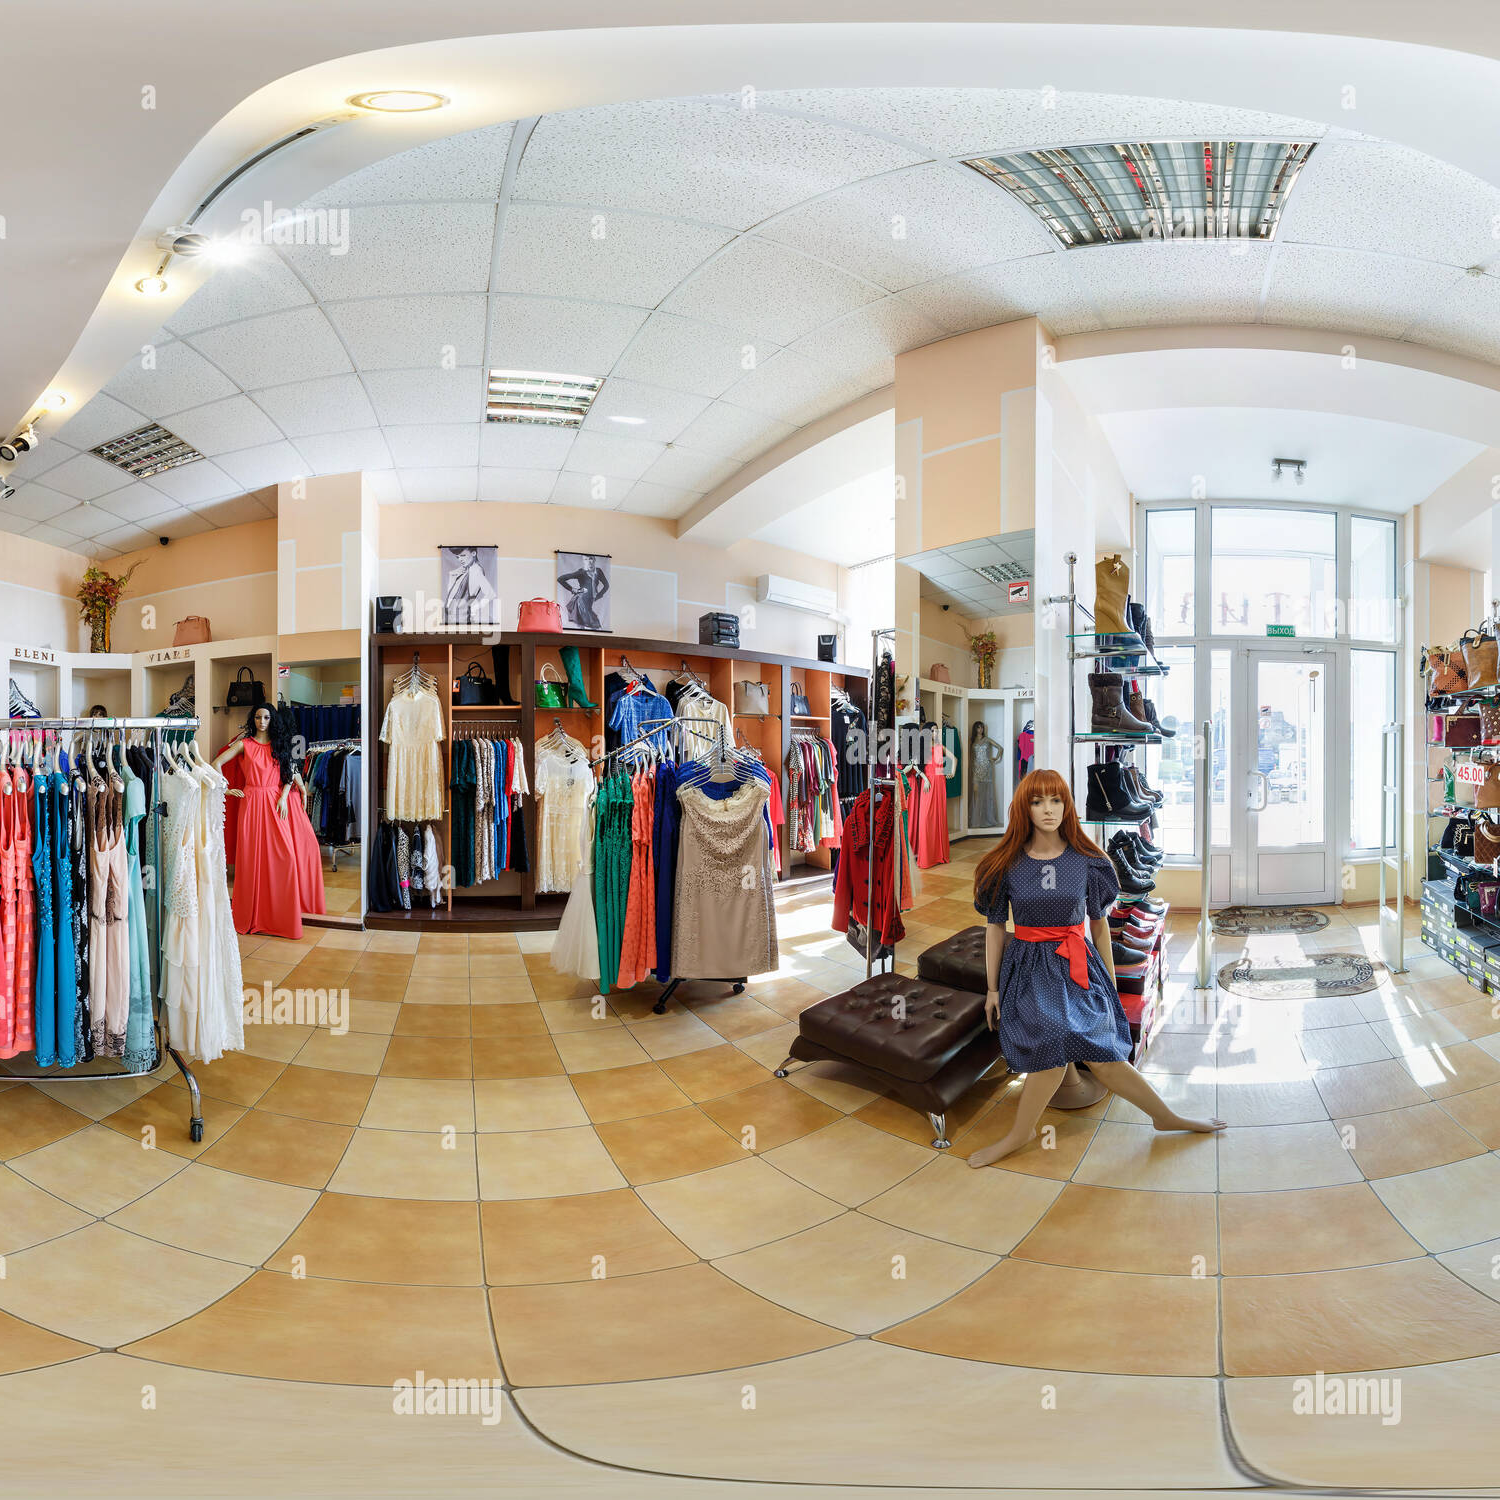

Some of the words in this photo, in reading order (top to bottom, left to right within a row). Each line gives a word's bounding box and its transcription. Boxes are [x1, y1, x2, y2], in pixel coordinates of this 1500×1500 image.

[1267, 627, 1296, 636] ВЫХОД
[14, 647, 55, 662] ELENI
[1457, 766, 1483, 783] 45.00
